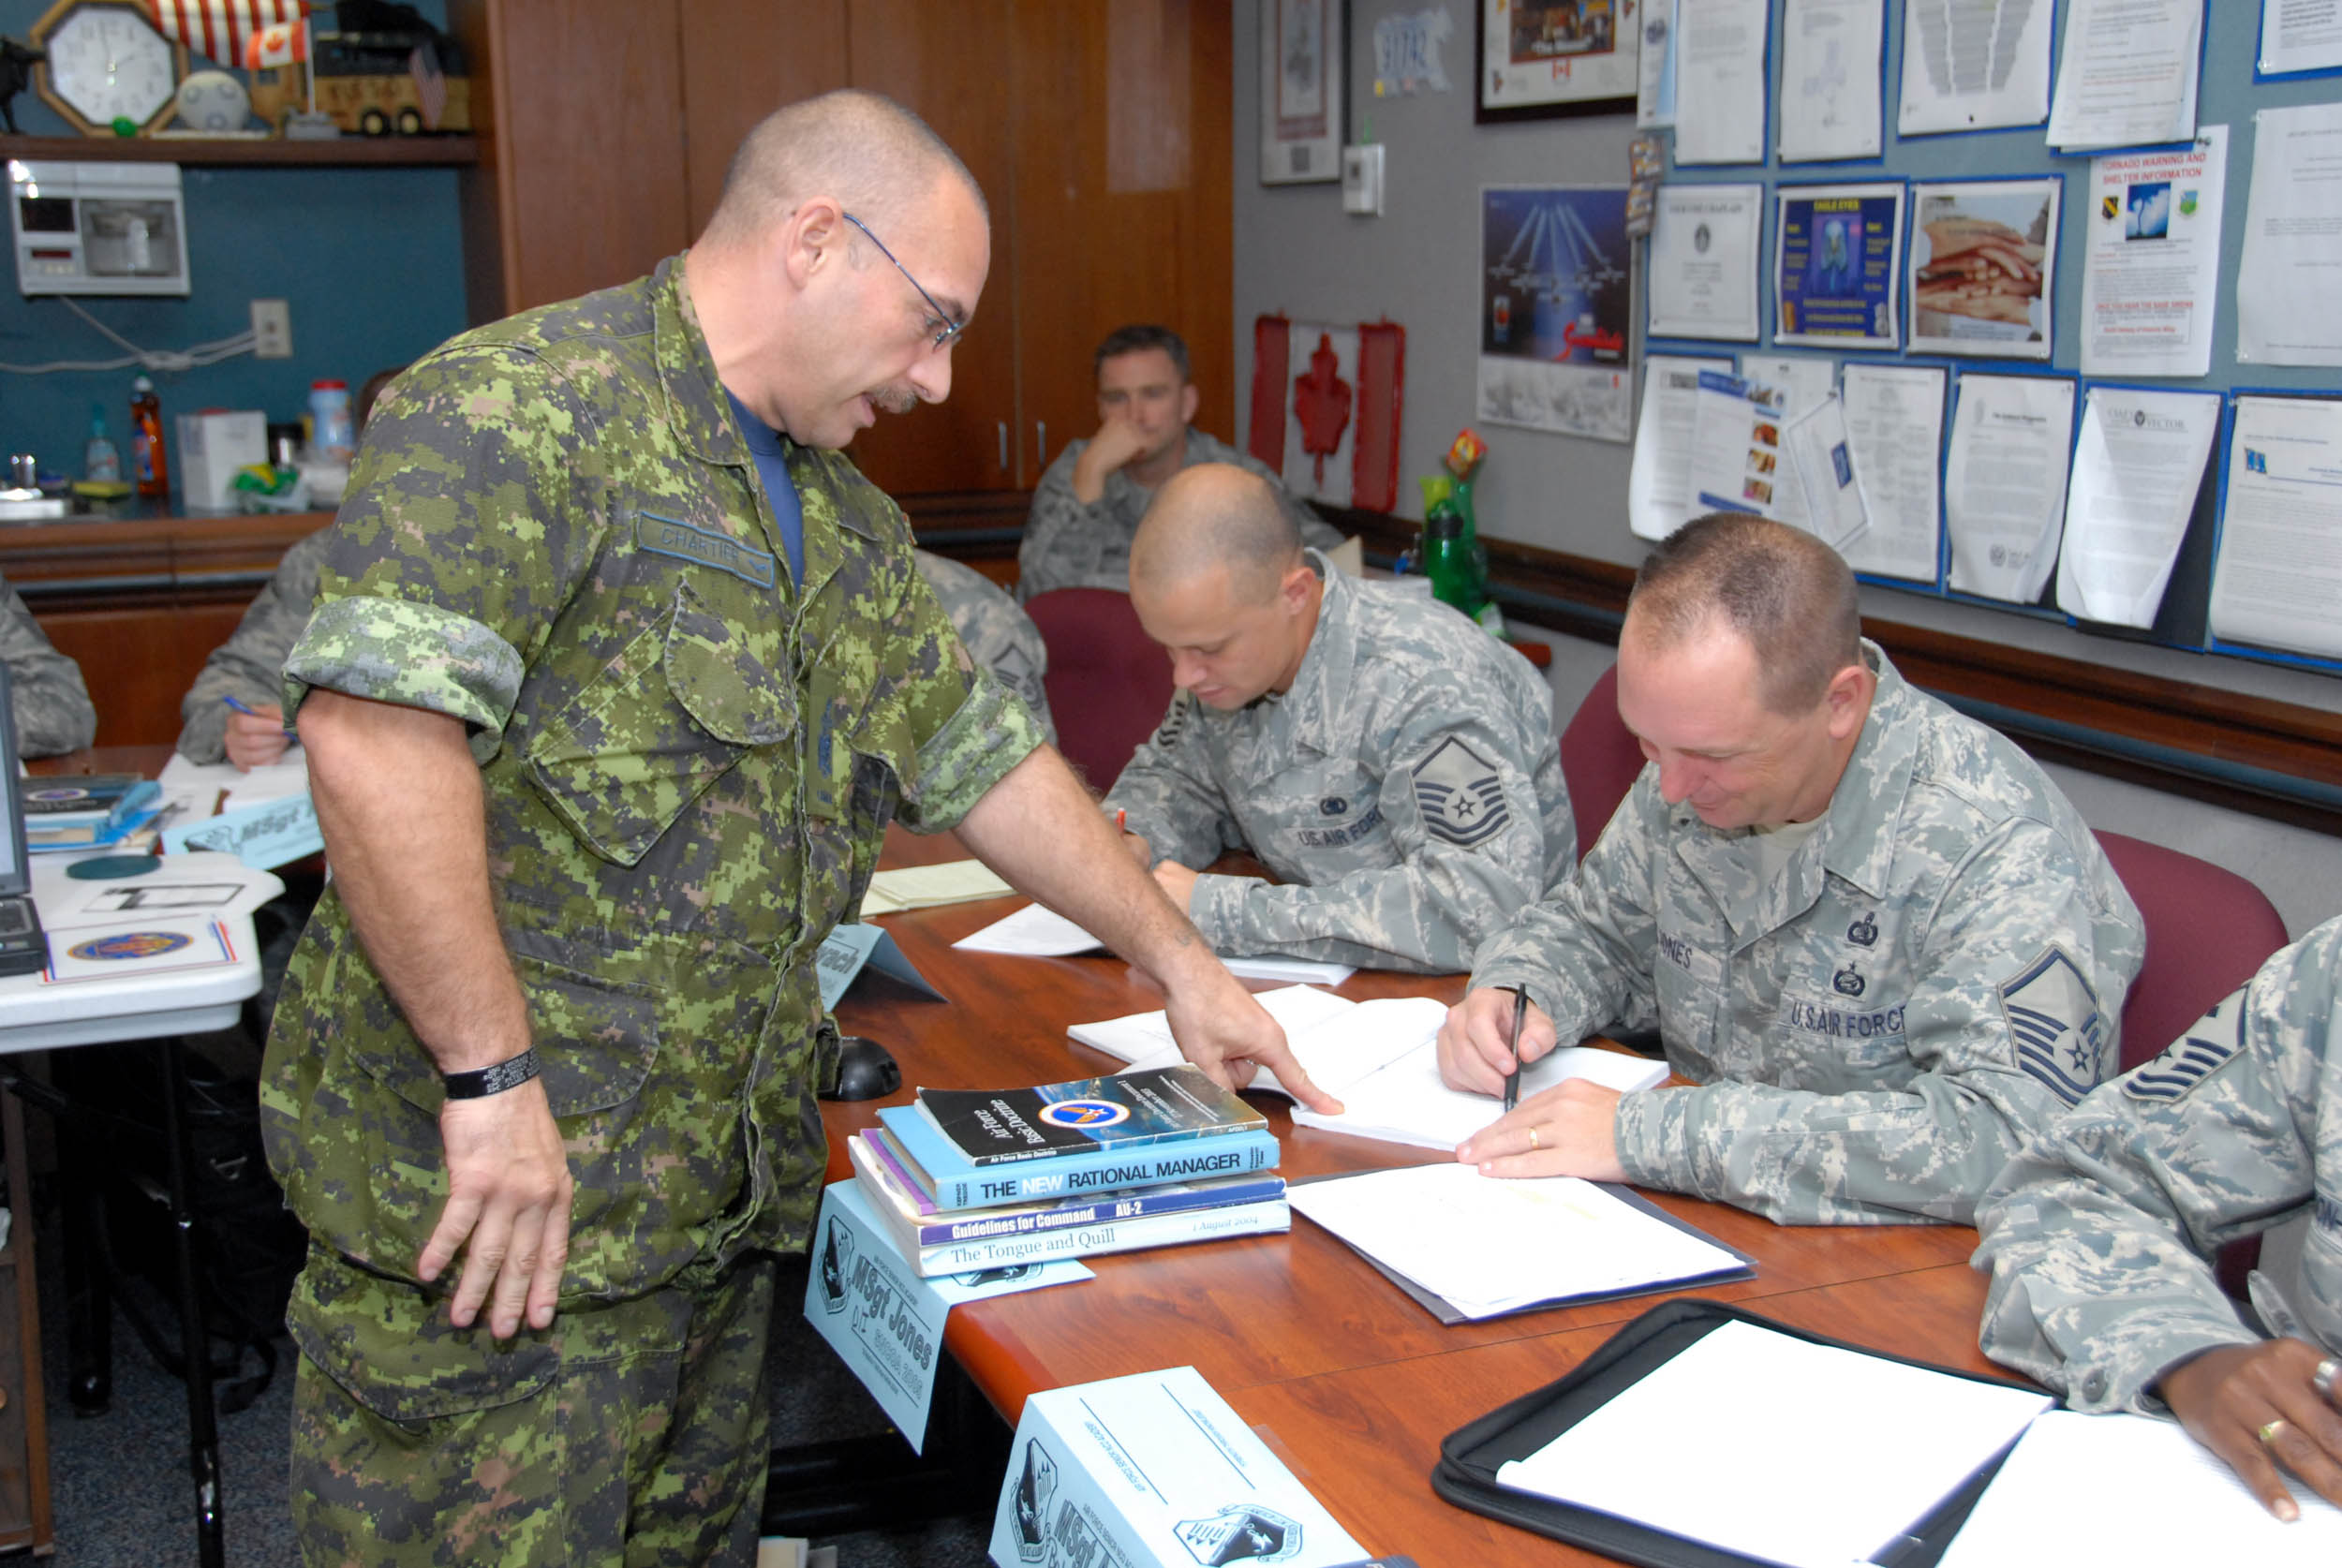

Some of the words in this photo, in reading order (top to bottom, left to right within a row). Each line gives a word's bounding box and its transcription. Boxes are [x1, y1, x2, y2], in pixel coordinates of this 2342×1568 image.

[2142, 168, 2202, 181] INFORMATION
[2186, 152, 2207, 163] AND
[1323, 829, 1349, 846] AIR
[1349, 805, 1385, 840] FOR
[981, 1180, 1016, 1199] THE
[1022, 1174, 1063, 1195] NEW
[1068, 1163, 1152, 1189] RATIONAL
[1156, 1153, 1240, 1177] MANAGER
[1000, 1154, 1016, 1162] Force
[951, 1247, 981, 1264] The
[984, 1239, 1042, 1259] Tongue
[1046, 1235, 1075, 1250] and
[1078, 1227, 1116, 1248] Quill
[1199, 1218, 1233, 1232] August
[1235, 1215, 1259, 1226] 2004
[952, 1220, 1015, 1239] Guidelines
[1016, 1216, 1035, 1230] for
[1036, 1206, 1095, 1229] Command
[1116, 1200, 1143, 1218] AU-2
[852, 1253, 891, 1319] MSgt
[889, 1298, 932, 1370] Jones
